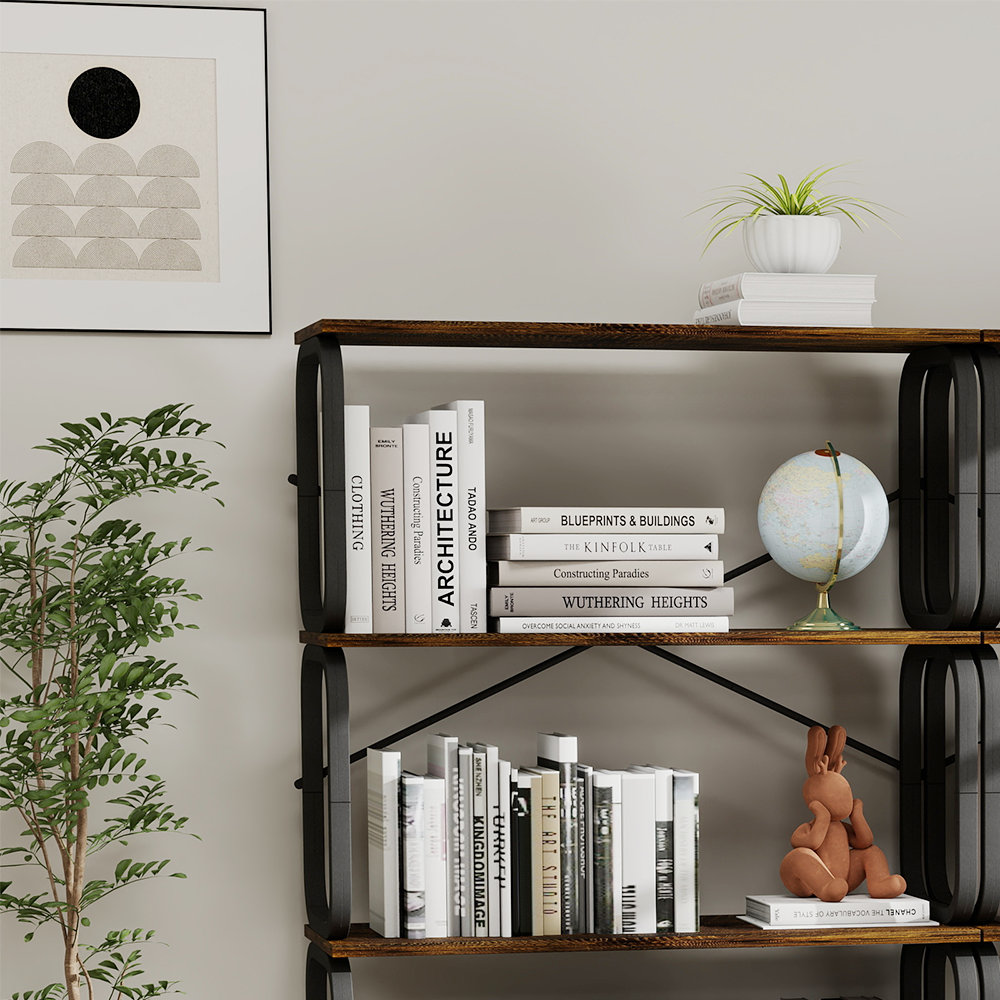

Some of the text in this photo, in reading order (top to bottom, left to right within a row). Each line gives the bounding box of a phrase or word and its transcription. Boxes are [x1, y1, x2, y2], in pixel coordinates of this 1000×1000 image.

[351, 475, 364, 550] CLOTHING
[410, 476, 424, 564] Constructing Paradies
[436, 432, 454, 607] ARCHITECTURE
[468, 487, 477, 551] TADAO ANDO
[561, 515, 696, 527] BLUEPRINTS & BUILDINGS
[380, 488, 397, 612] WUTHERING HEIGHTS
[554, 568, 650, 580] Constructing Paradies
[584, 542, 646, 553] KINFOLK
[562, 596, 708, 608] WUTHERING HEIGHTS
[542, 796, 557, 914] THE ART STUDIO
